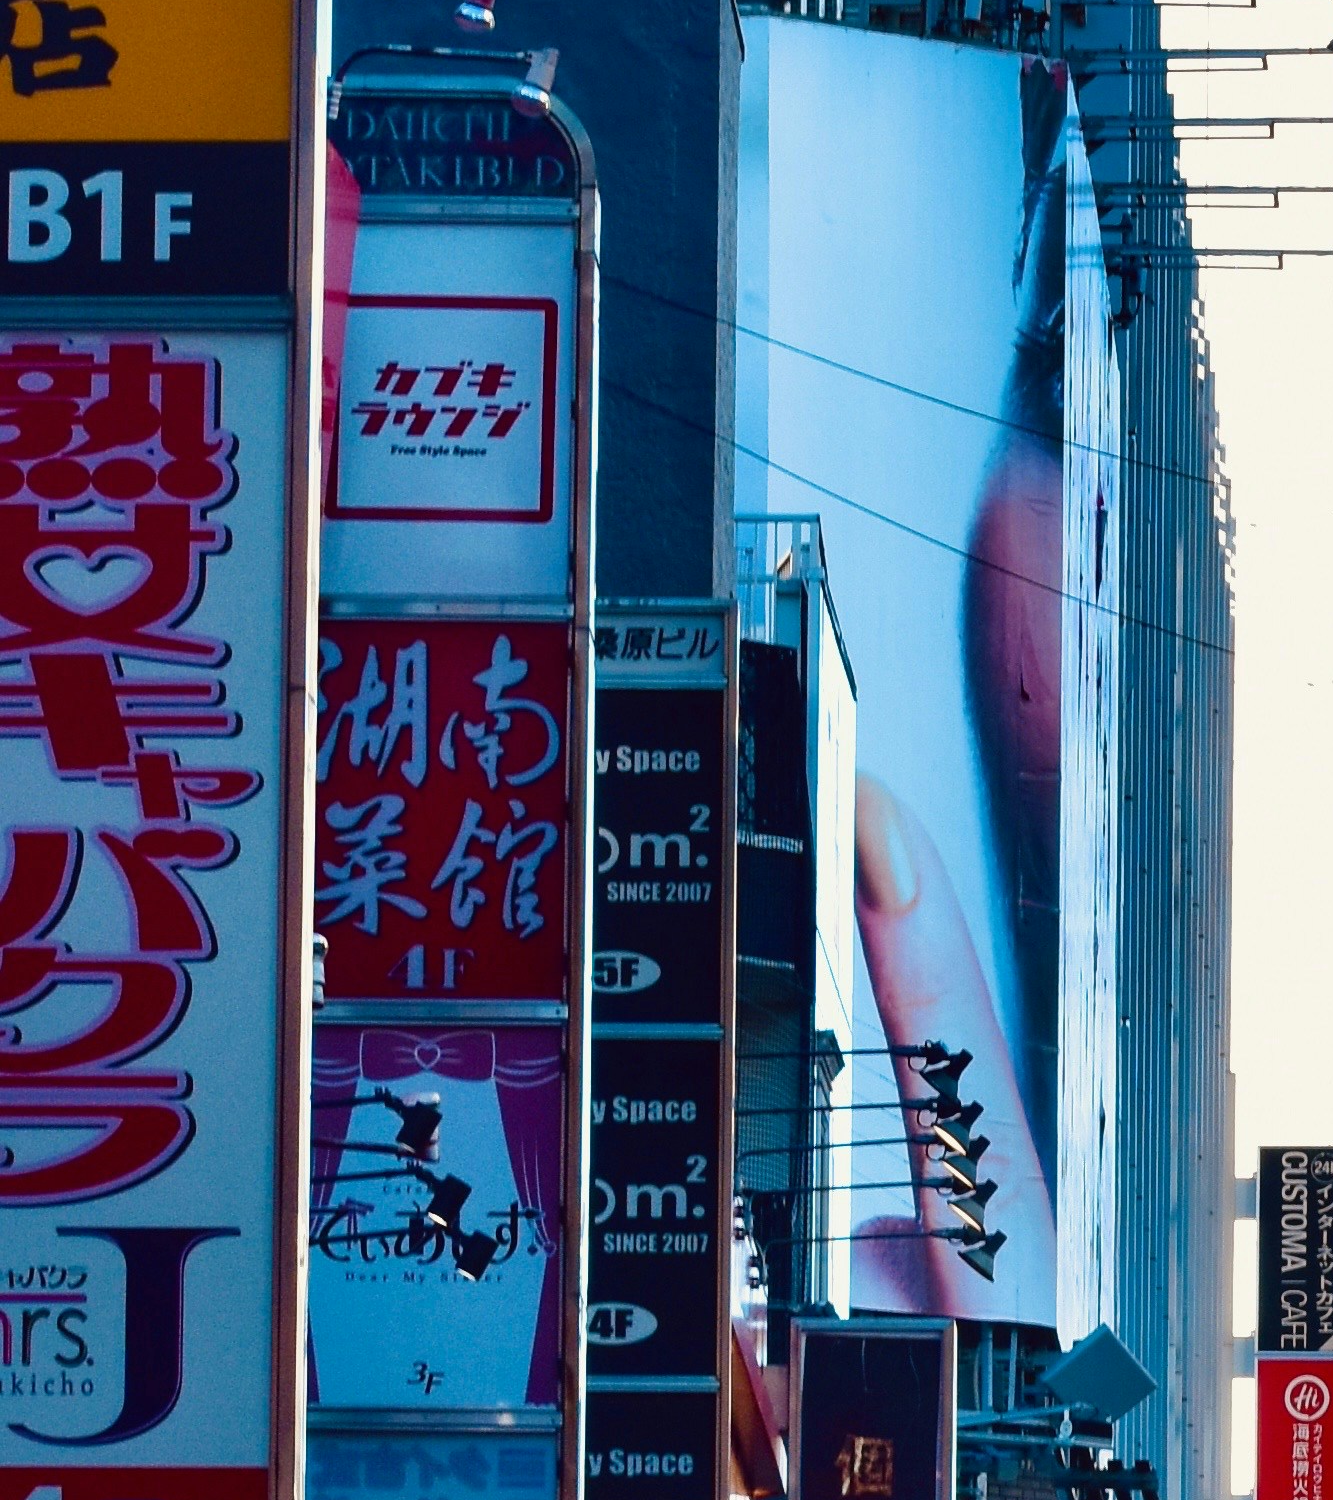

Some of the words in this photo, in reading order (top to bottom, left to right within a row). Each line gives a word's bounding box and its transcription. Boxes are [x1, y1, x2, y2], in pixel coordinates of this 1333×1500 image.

[373, 362, 516, 397] カブキ
[350, 402, 533, 439] ラウンジ
[391, 444, 417, 457] Free
[419, 445, 450, 460] Style
[453, 445, 488, 459] Space
[616, 744, 701, 776] Space
[607, 881, 662, 902] SINCE
[666, 881, 713, 902] 2007
[388, 945, 475, 991] 4F
[598, 956, 641, 988] 5F
[612, 1095, 698, 1124] Space
[1280, 1150, 1308, 1274] CUSTOMA
[604, 1233, 658, 1254] SINCE
[663, 1233, 709, 1254] 2007
[1280, 1290, 1308, 1350] CAFE
[407, 1361, 445, 1395] 3F
[609, 1449, 694, 1477] Space
